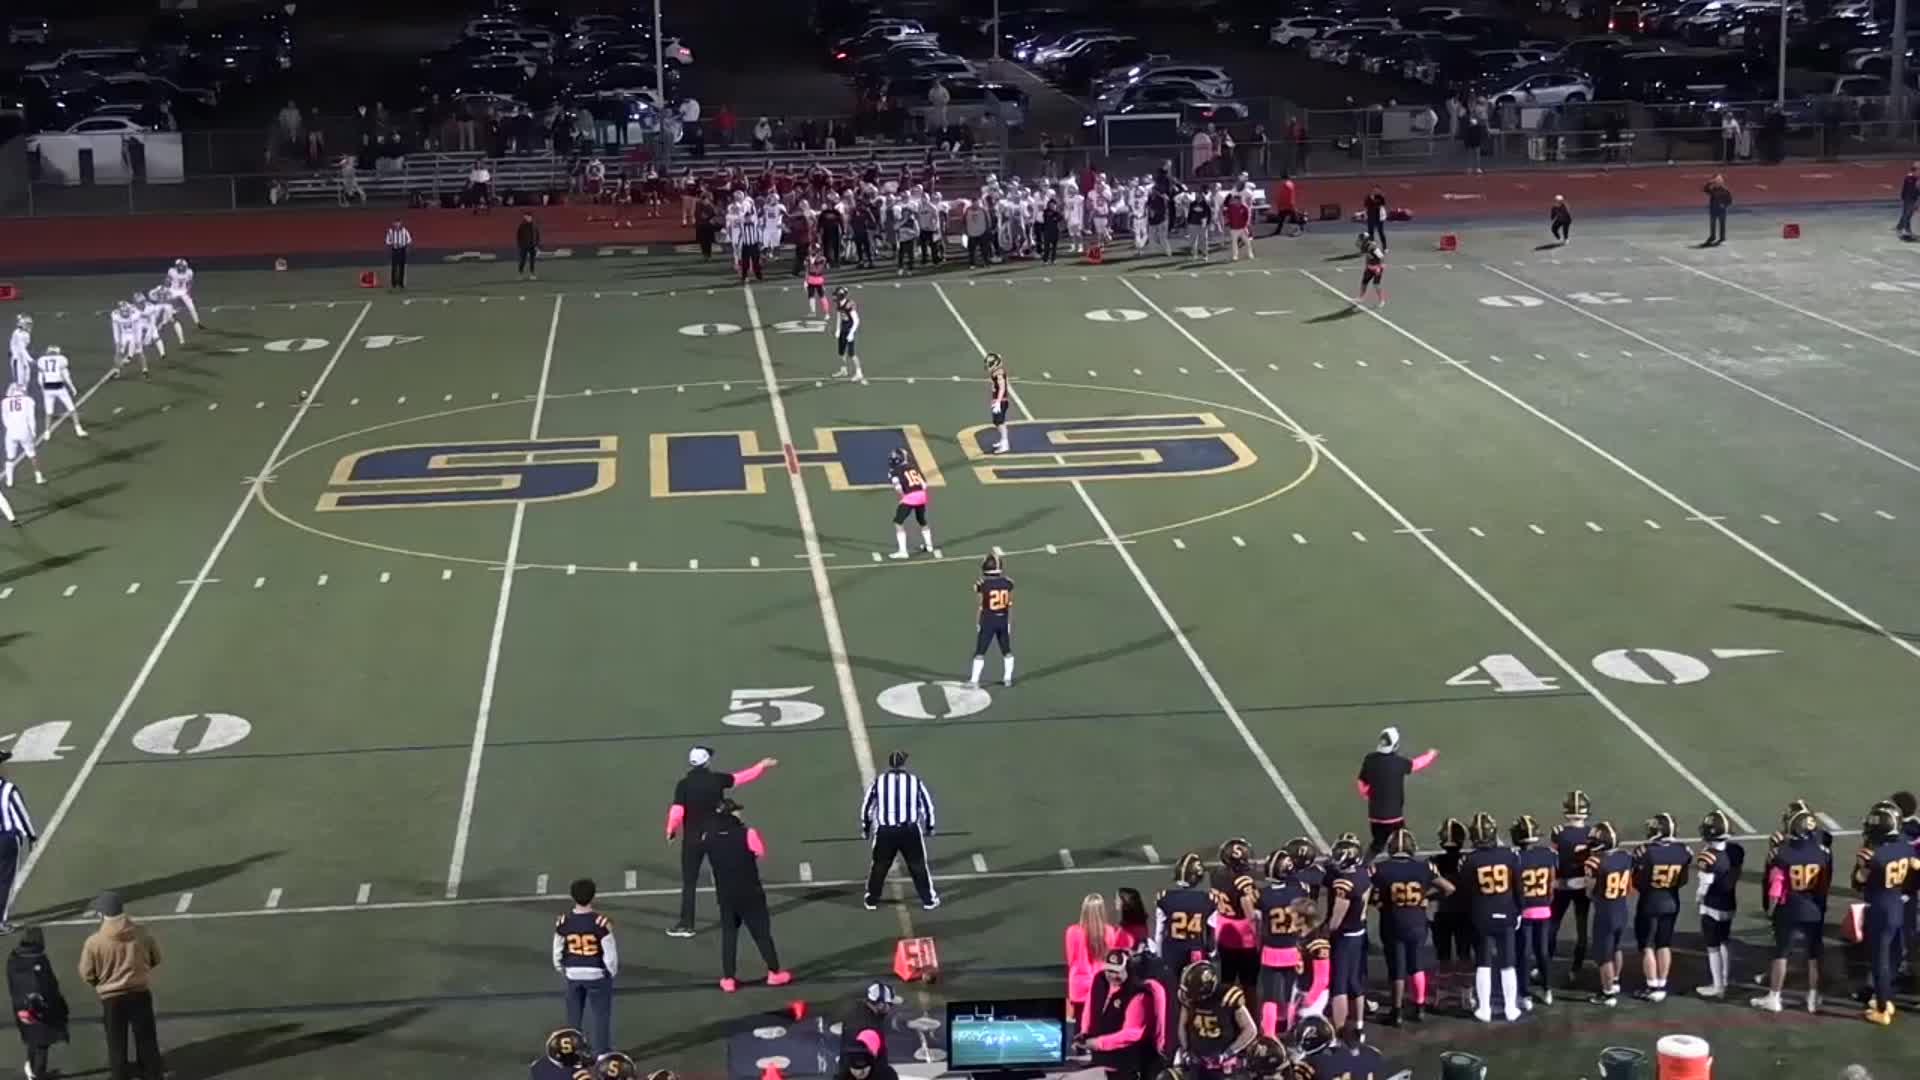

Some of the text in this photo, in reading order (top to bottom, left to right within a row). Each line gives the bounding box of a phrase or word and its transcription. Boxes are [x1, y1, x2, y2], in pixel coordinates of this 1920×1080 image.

[315, 411, 1258, 512] SHS
[904, 469, 922, 488] 16
[989, 589, 1009, 610] 20
[1477, 863, 1510, 895] 59
[1521, 866, 1550, 897] 23
[1170, 910, 1203, 940] 24
[566, 933, 599, 957] 26
[560, 1036, 574, 1054] S
[606, 1059, 620, 1078] S
